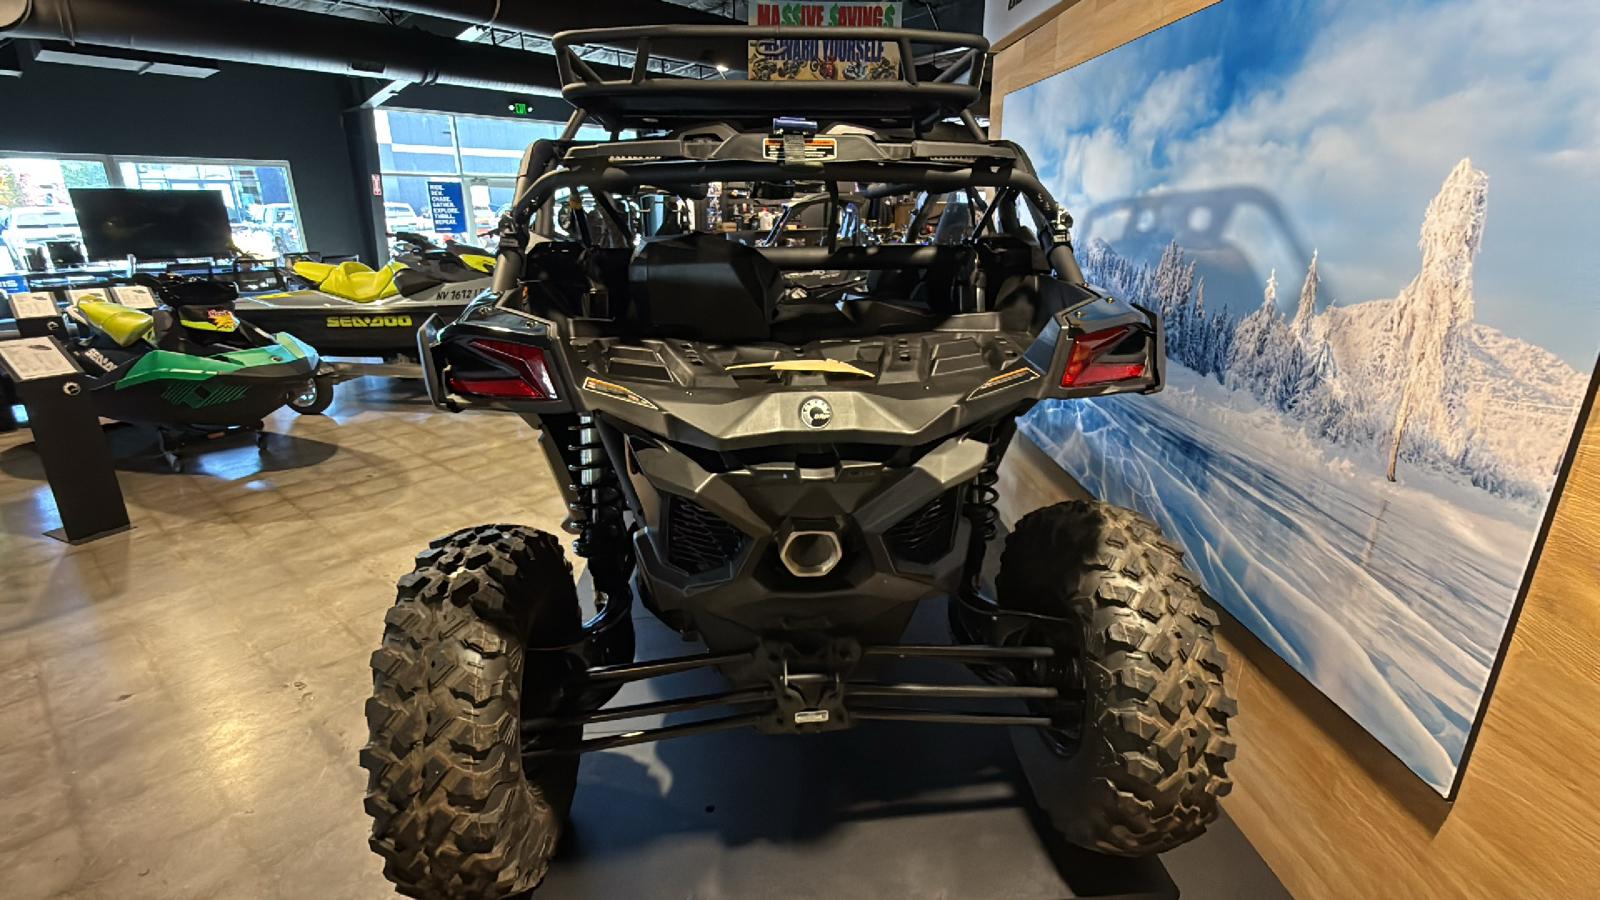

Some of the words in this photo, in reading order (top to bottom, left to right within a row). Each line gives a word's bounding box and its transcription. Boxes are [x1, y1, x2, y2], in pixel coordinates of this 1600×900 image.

[822, 39, 884, 62] YOURSELF
[436, 291, 449, 300] NV
[451, 289, 472, 300] 1612
